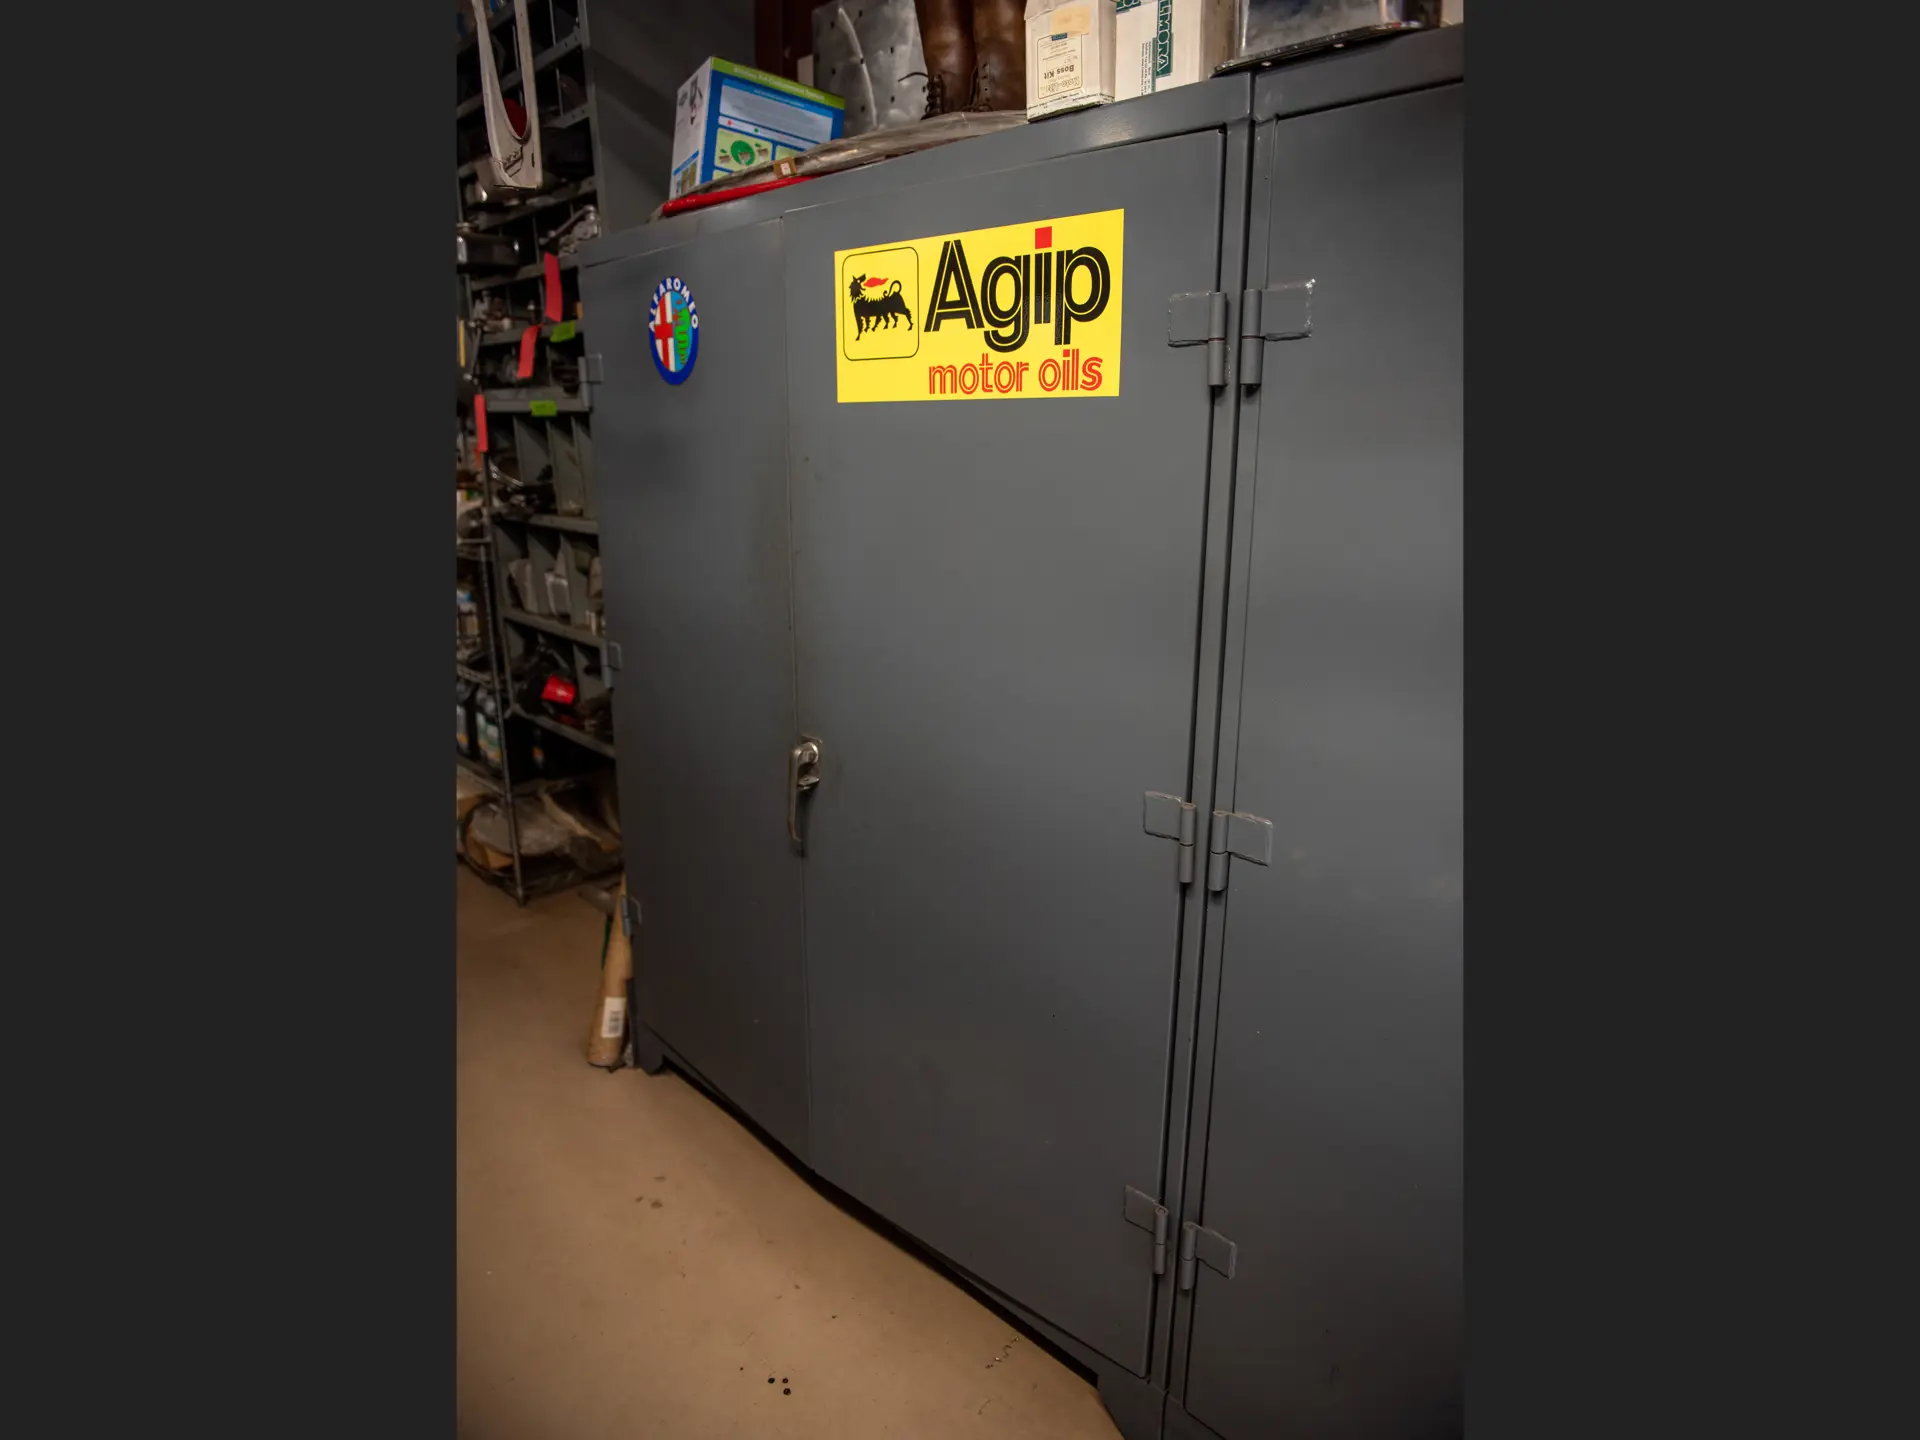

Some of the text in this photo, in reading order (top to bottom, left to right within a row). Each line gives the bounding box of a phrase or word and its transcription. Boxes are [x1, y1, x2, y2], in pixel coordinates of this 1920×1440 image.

[1043, 64, 1075, 80] Boss Kit
[924, 226, 1111, 353] Agip
[929, 348, 1104, 395] motor oils
